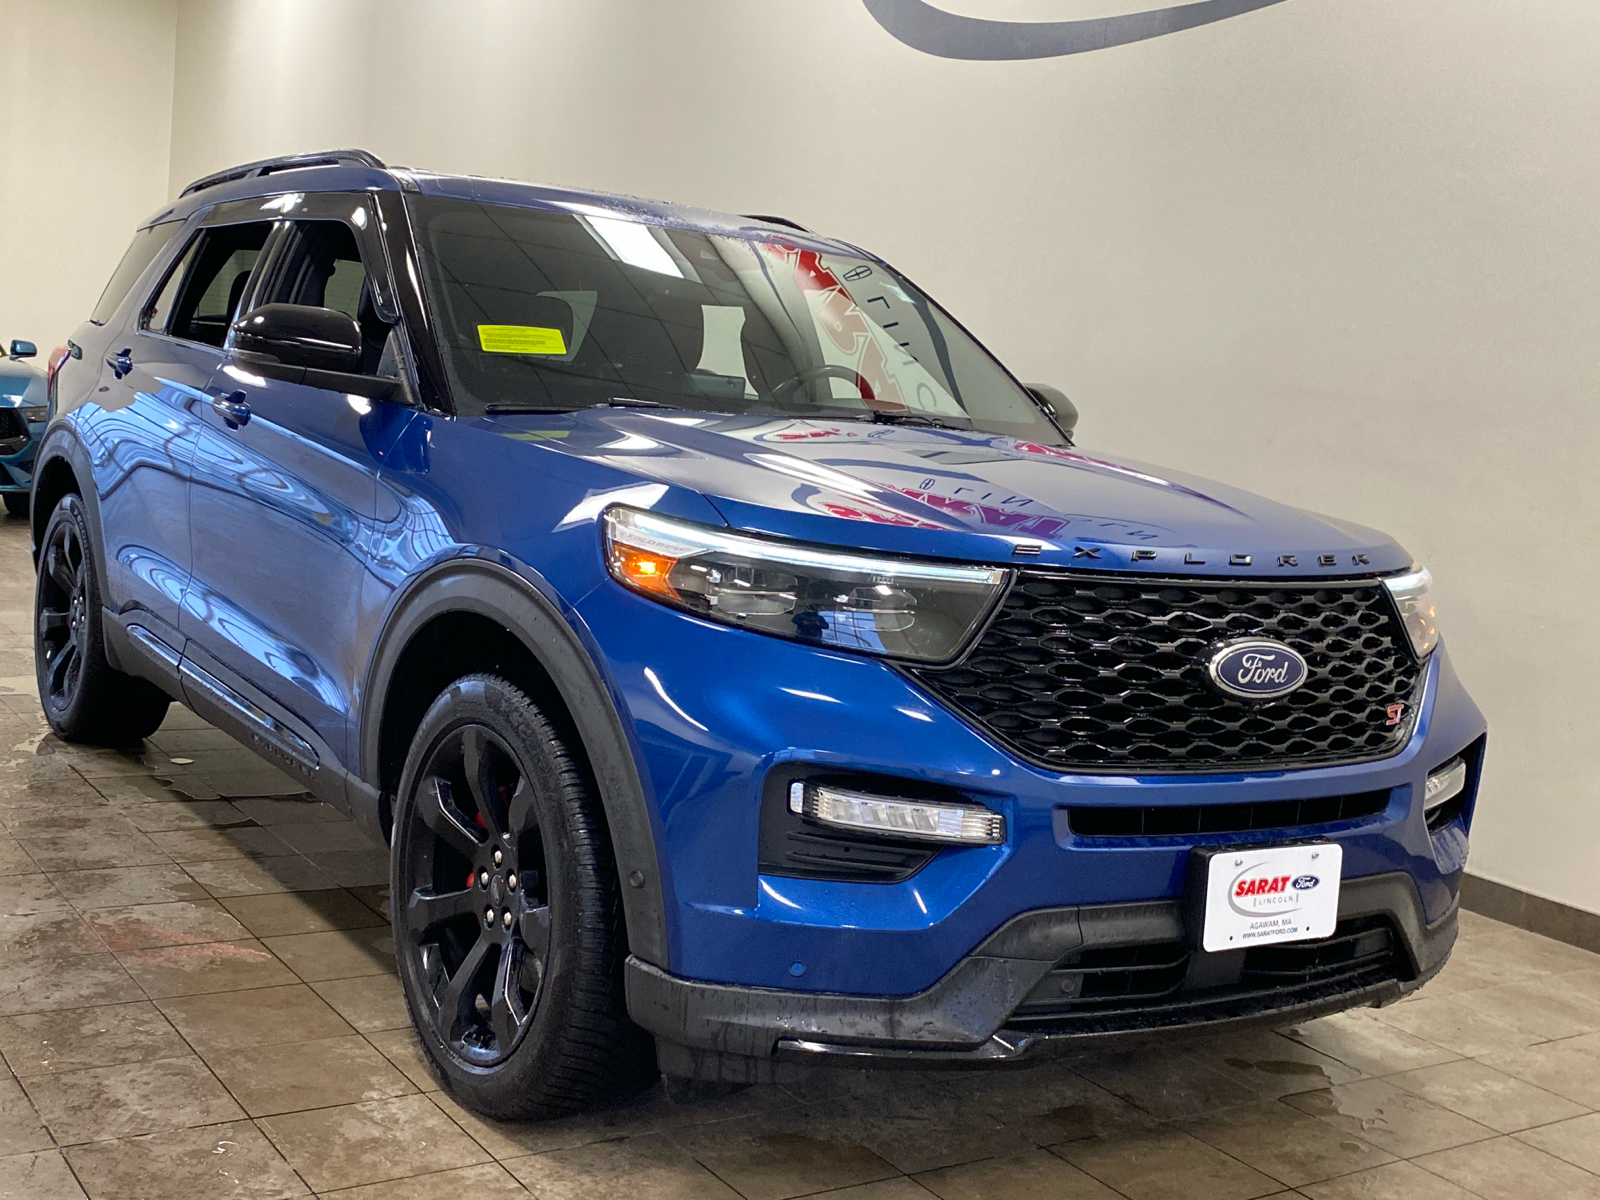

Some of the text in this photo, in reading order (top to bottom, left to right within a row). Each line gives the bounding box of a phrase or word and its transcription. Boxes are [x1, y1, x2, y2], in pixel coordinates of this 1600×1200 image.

[619, 531, 684, 552] EXPLORER
[1011, 542, 1371, 567] EXPLORER
[1237, 653, 1289, 684] Ford
[1386, 703, 1405, 726] ST
[1234, 875, 1316, 897] SARAT Ford
[1259, 895, 1293, 905] LINCOLN
[1242, 927, 1298, 939] WWW.SARATFORD.COM
[1250, 918, 1293, 930] AGAWAM, MA
